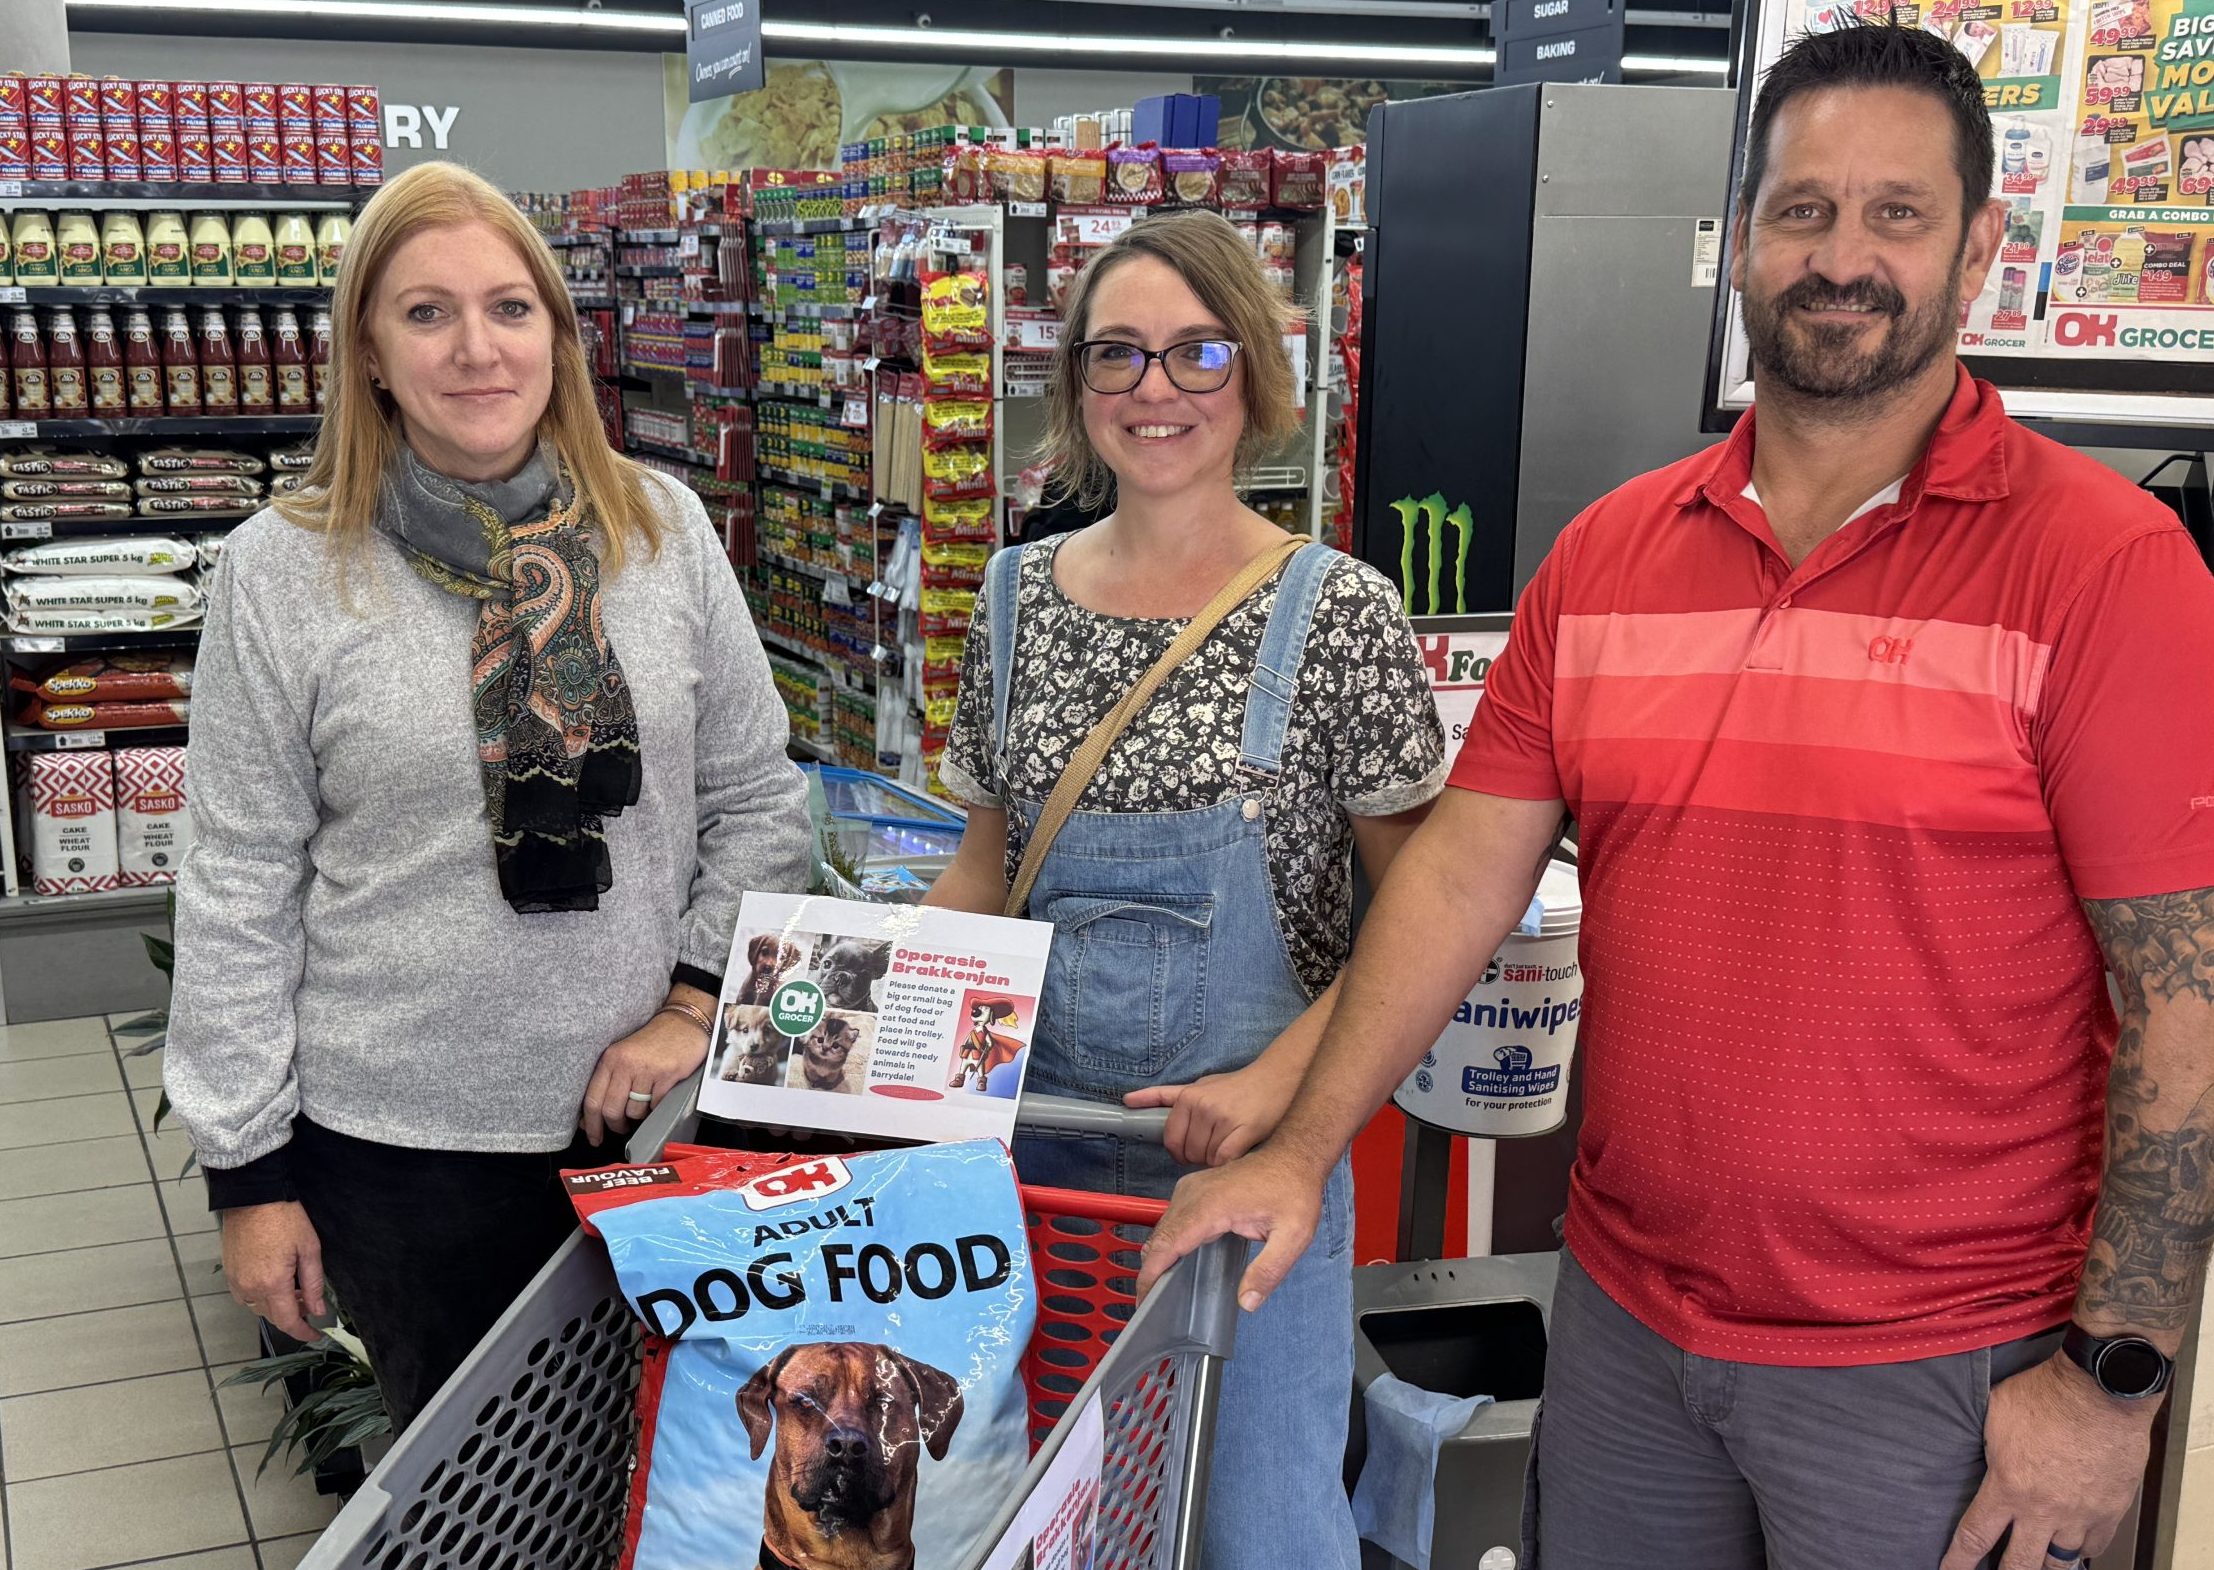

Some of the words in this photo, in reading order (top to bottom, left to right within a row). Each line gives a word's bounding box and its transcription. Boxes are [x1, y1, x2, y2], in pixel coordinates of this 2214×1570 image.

[701, 8, 726, 29] CANNED
[727, 2, 743, 21] FOOD
[1533, 1, 1568, 19] SUGAR
[1536, 40, 1576, 60] BAKING
[2161, 37, 2214, 60] SAV
[385, 105, 460, 149] RY
[2109, 210, 2145, 220] GRAB
[2149, 210, 2158, 220] A
[2162, 211, 2210, 221] COMBO
[2055, 312, 2118, 347] OK
[1961, 333, 1984, 346] OK
[1984, 339, 2026, 348] GROCER
[12, 462, 47, 472] TASTIC
[153, 459, 187, 468] TASTIC
[17, 485, 53, 494] TASTIC
[150, 480, 184, 489] TASTIC
[153, 500, 187, 509] TASTIC
[15, 508, 51, 517] TASTIC
[33, 557, 61, 565] WHITE
[64, 556, 88, 564] STAR
[90, 555, 120, 563] SUPER
[122, 554, 128, 562] 5
[131, 554, 143, 563] kg
[36, 597, 67, 605] WHITE
[95, 596, 124, 604] SUPER
[135, 596, 147, 605] kg
[94, 620, 123, 628] SUPER
[133, 619, 145, 627] kg
[49, 677, 91, 691] Spekko
[56, 802, 92, 815] SASKO
[140, 798, 175, 811] SASKO
[896, 948, 987, 968] Operasie
[892, 962, 1010, 986] Brakkenjan
[1503, 962, 1577, 982] sani-touch
[889, 980, 916, 990] Please
[918, 984, 948, 994] donate
[780, 989, 818, 1013] OK
[887, 992, 900, 1001] big
[913, 995, 935, 1004] small
[936, 997, 953, 1008] bag
[895, 1004, 911, 1014] dog
[913, 1006, 933, 1015] food
[1452, 997, 1582, 1035] aniwipe
[778, 1012, 814, 1023] GROCER
[898, 1015, 917, 1024] food
[880, 1026, 903, 1034] place
[904, 1027, 912, 1035] in
[914, 1029, 944, 1040] trolley.
[877, 1036, 898, 1045] Food
[900, 1038, 915, 1046] will
[916, 1041, 927, 1049] go
[876, 1048, 910, 1058] towards
[912, 1052, 938, 1062] needy
[873, 1059, 906, 1069] animals
[907, 1061, 915, 1070] in
[871, 1070, 914, 1082] Barrydale!
[1469, 1068, 1510, 1083] Trolley
[1512, 1071, 1532, 1081] and
[1534, 1067, 1557, 1079] Hand
[1468, 1081, 1525, 1095] Sanitising
[1528, 1081, 1554, 1093] Wipes
[1465, 1097, 1479, 1107] for
[1483, 1100, 1507, 1110] your
[1508, 1097, 1552, 1111] protection
[570, 1167, 670, 1183] FLAVOUR
[602, 1176, 653, 1188] BEEF
[753, 1163, 837, 1197] OK
[754, 1196, 875, 1247] ADULT
[635, 1251, 807, 1340] DOG
[820, 1234, 1011, 1304] FOOD
